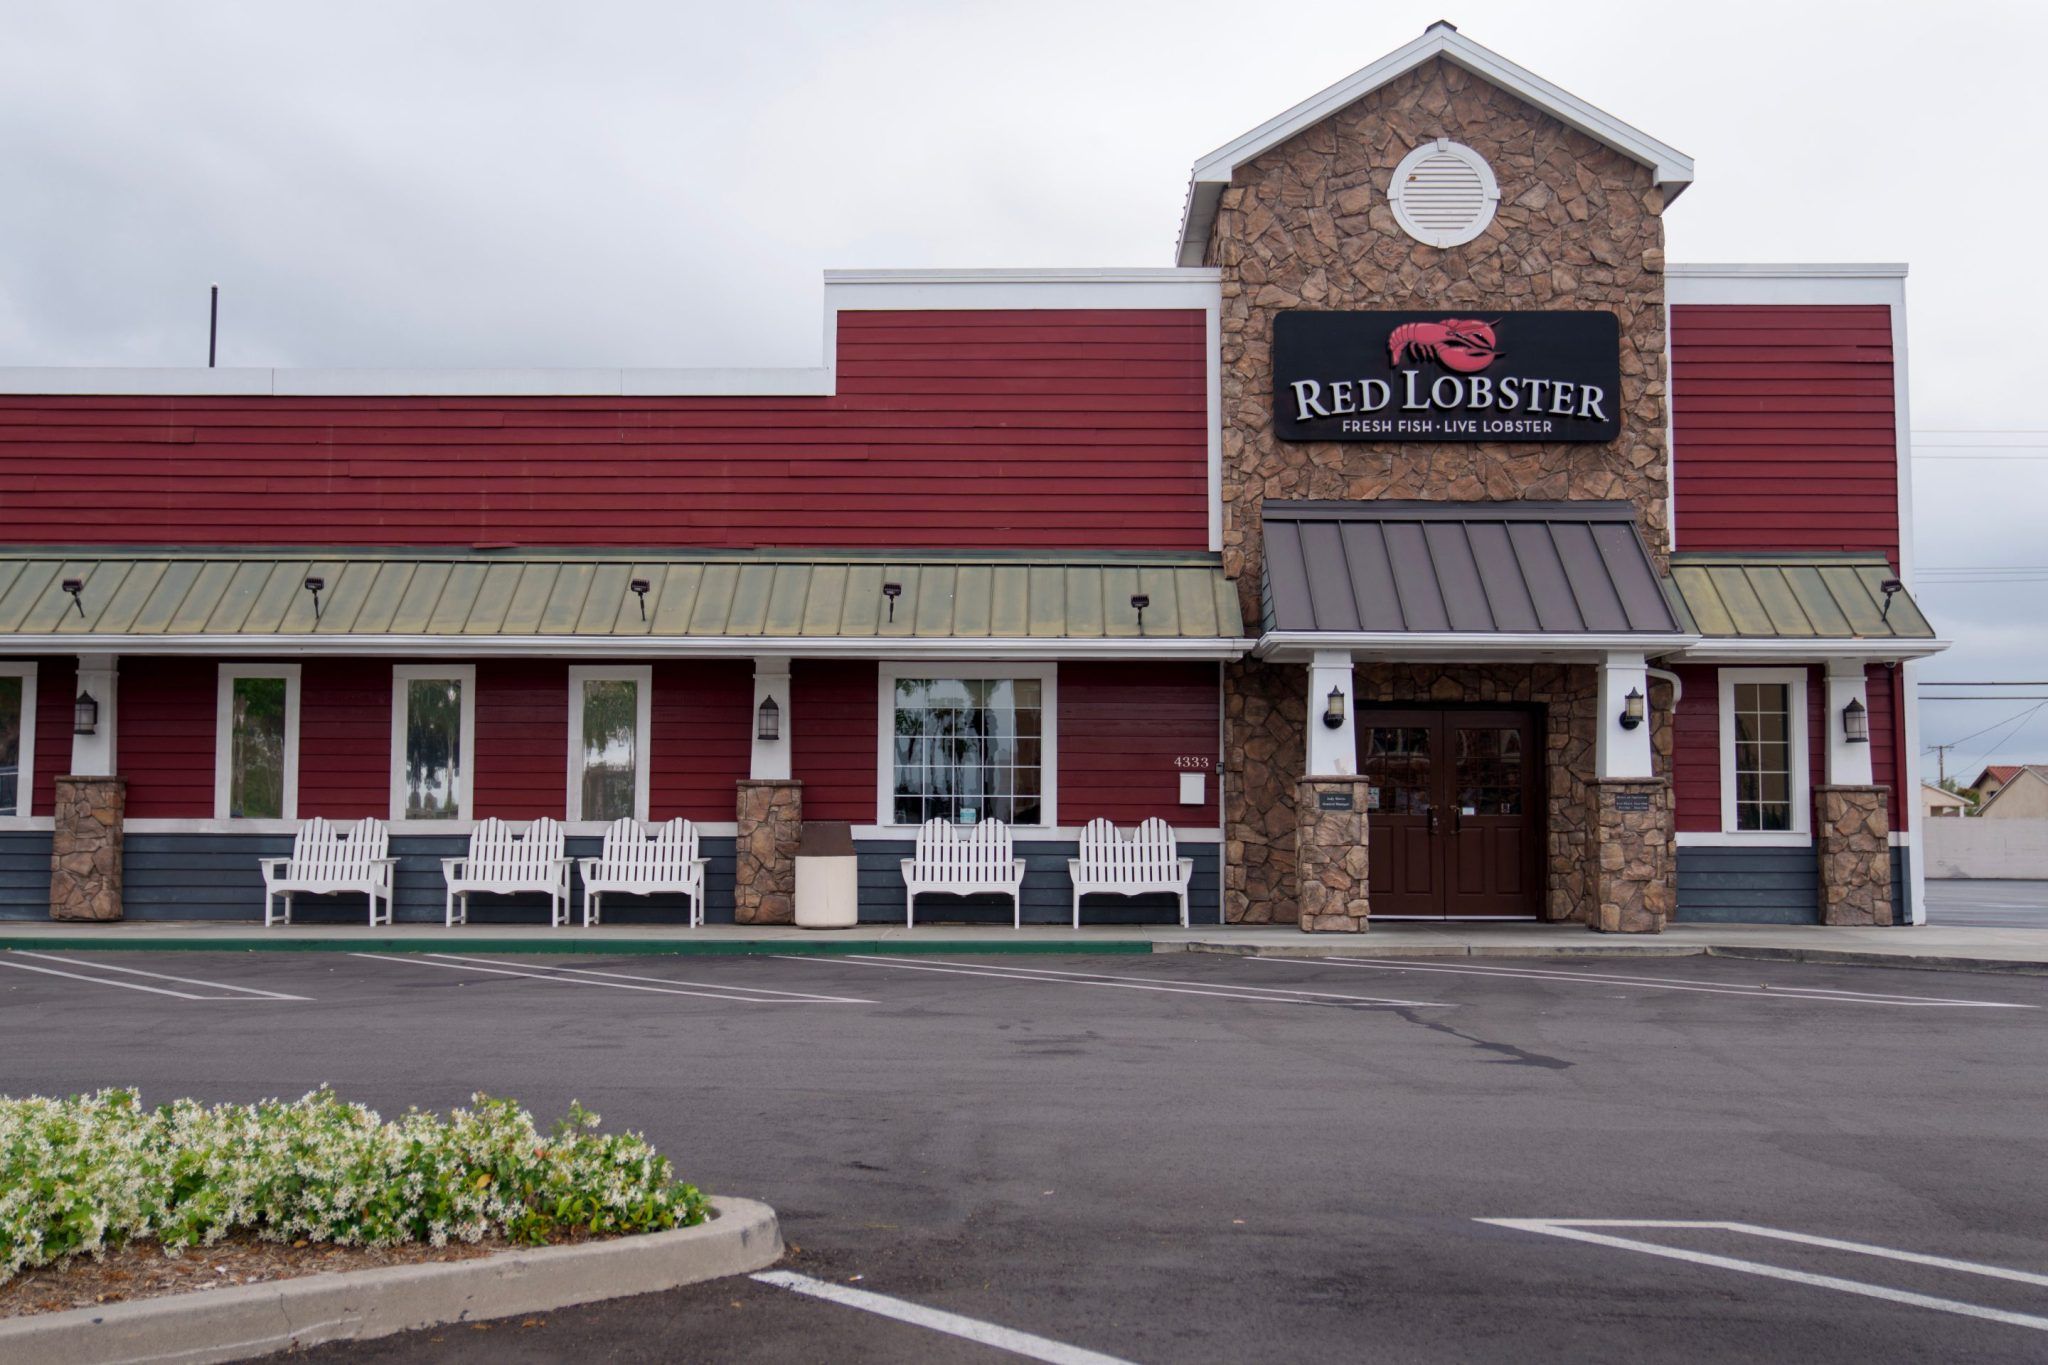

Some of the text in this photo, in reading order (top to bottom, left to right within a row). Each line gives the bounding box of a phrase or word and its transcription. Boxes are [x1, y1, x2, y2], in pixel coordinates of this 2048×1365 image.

[1290, 369, 1606, 421] RED LOBSTER
[1342, 420, 1552, 432] FRESH FISH LIVE LOBSTER
[1173, 756, 1209, 768] 4333
